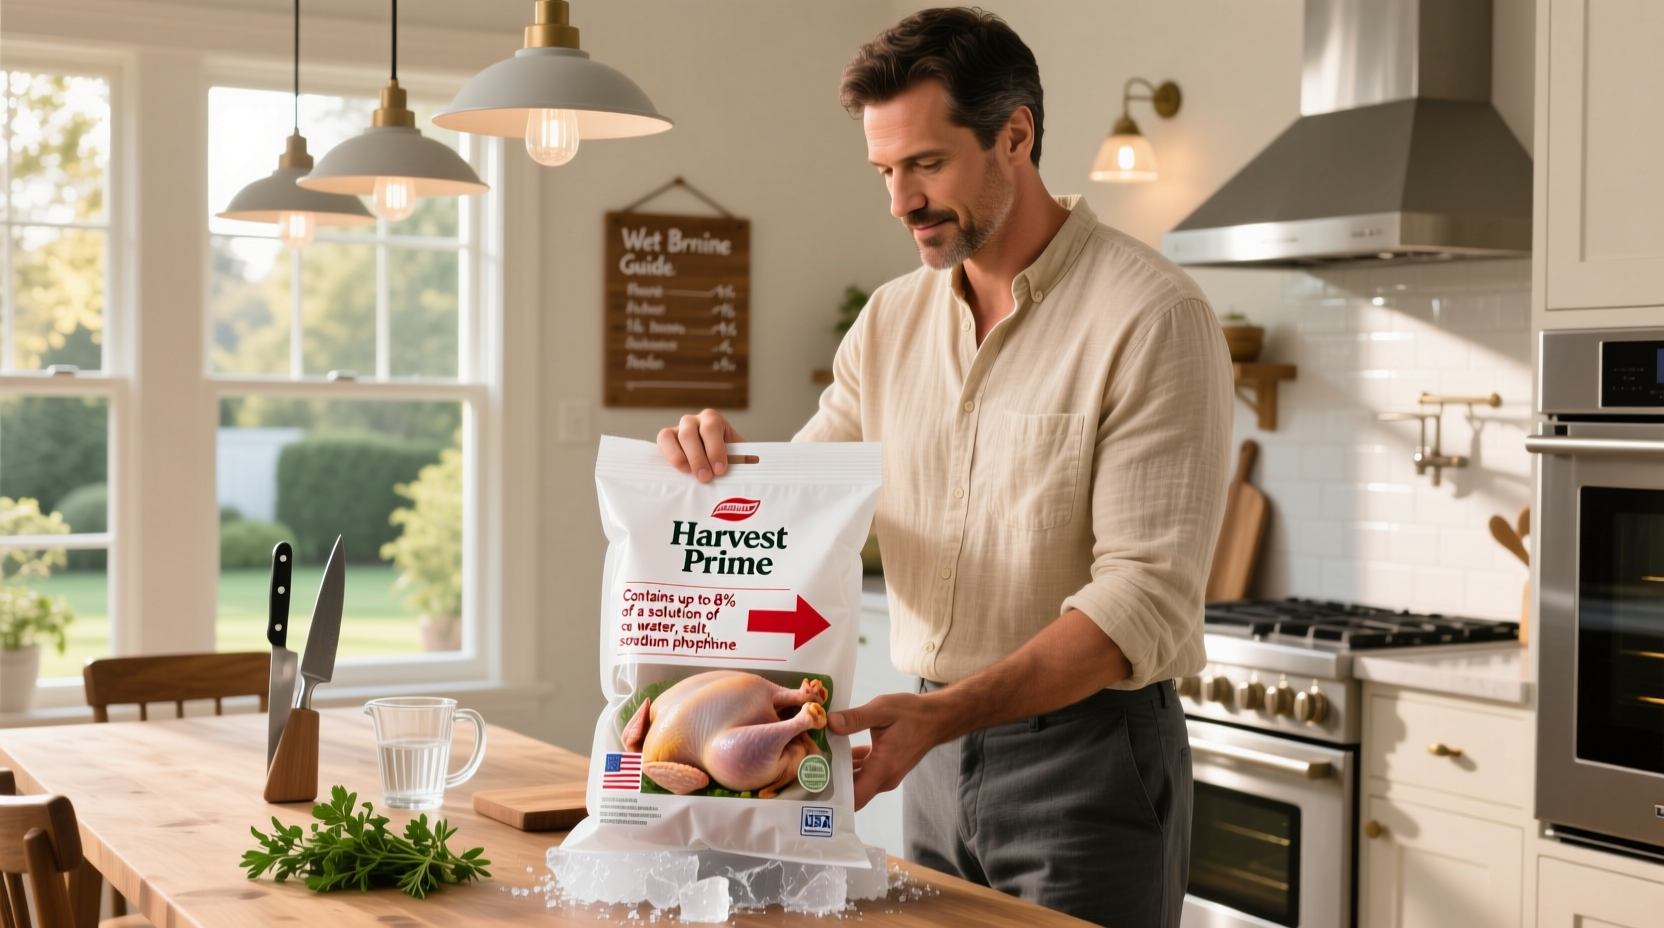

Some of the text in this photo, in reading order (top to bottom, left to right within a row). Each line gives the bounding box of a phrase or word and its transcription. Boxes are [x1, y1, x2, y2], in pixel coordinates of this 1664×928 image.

[621, 226, 662, 253] Wet
[670, 520, 788, 549] Harvest
[682, 548, 773, 575] Prime
[621, 604, 720, 620] of a solution of
[623, 589, 736, 608] Contains up to 8%
